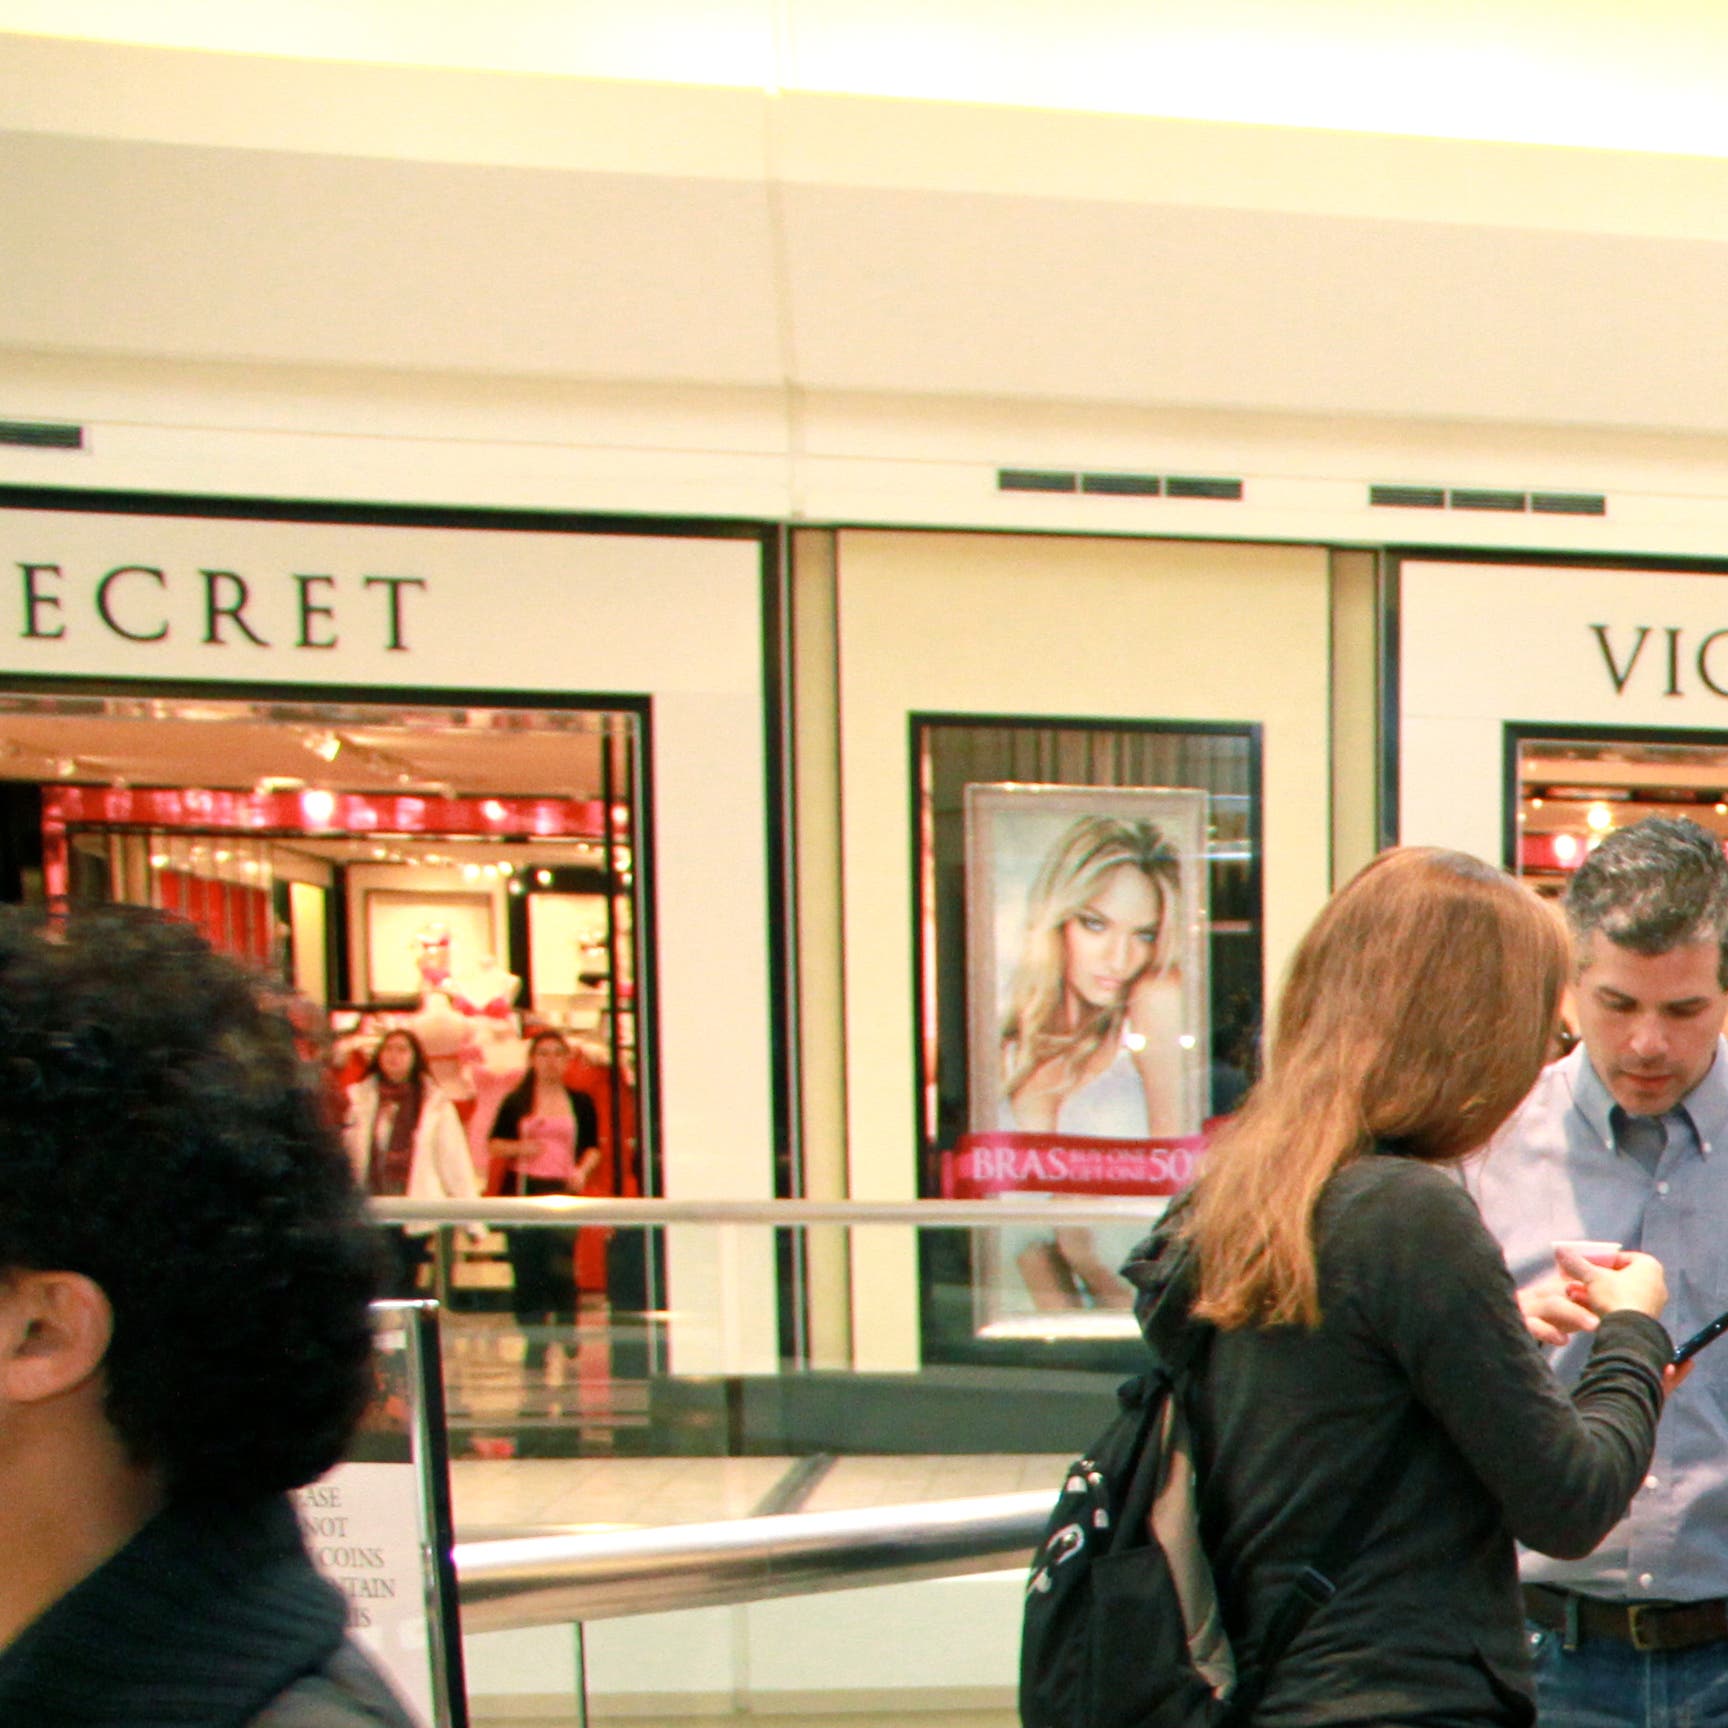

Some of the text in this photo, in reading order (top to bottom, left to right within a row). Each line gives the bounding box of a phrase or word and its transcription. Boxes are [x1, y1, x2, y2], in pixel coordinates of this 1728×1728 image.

[15, 562, 427, 652] ECRET
[973, 1147, 1069, 1181] BRAS
[320, 1547, 385, 1569] COINS
